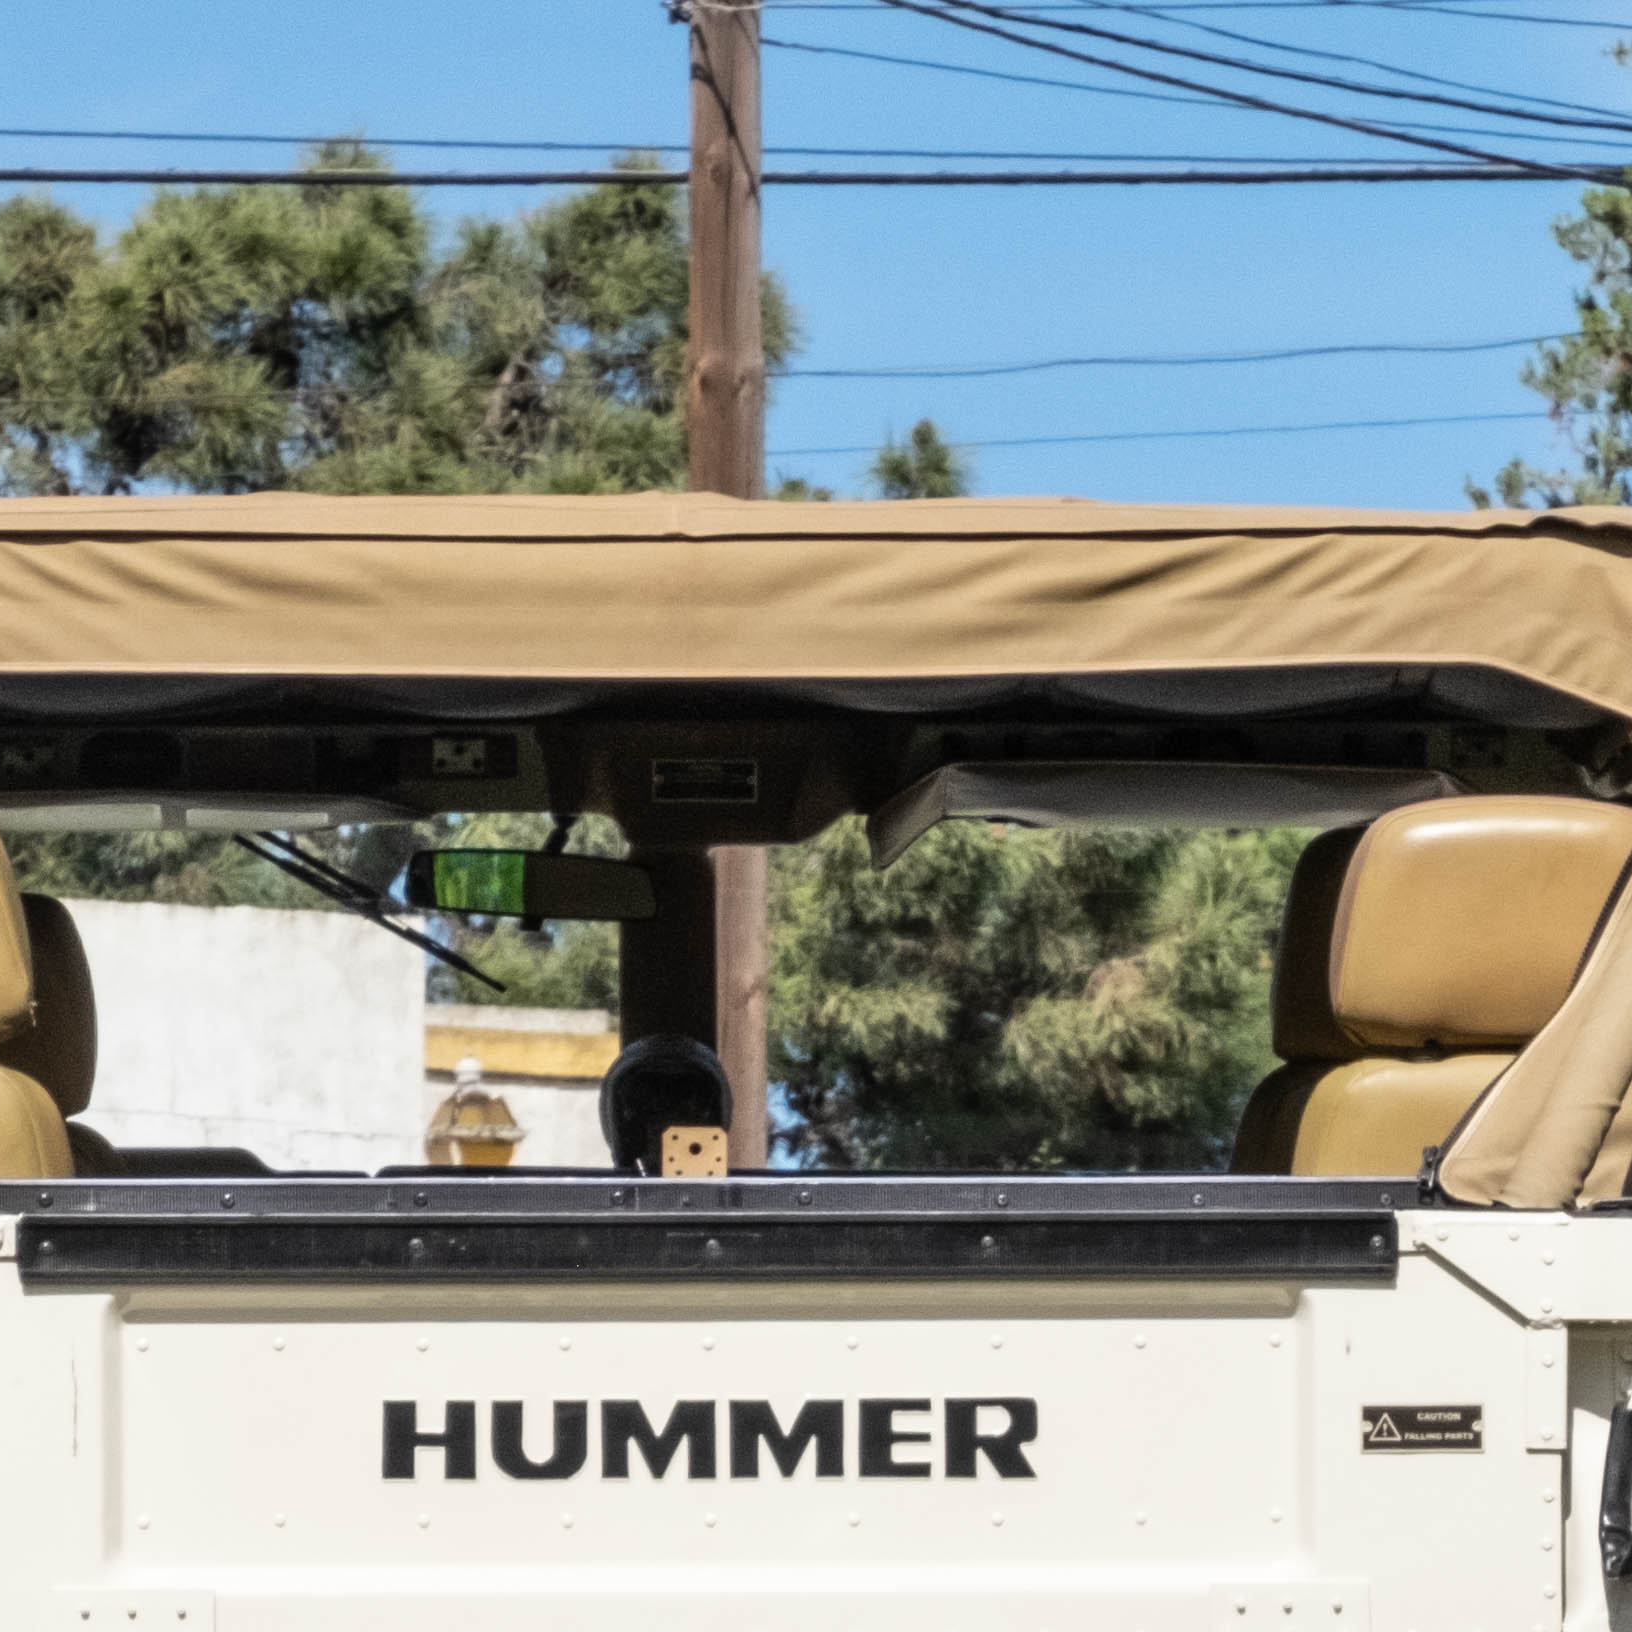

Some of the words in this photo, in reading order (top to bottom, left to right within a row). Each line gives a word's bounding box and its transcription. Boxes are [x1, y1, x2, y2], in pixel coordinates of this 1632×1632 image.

[1416, 1411, 1462, 1421] CAUTION
[382, 1398, 1039, 1480] HUMMER
[1404, 1432, 1442, 1440] FALLING
[1444, 1432, 1474, 1440] PARTS
